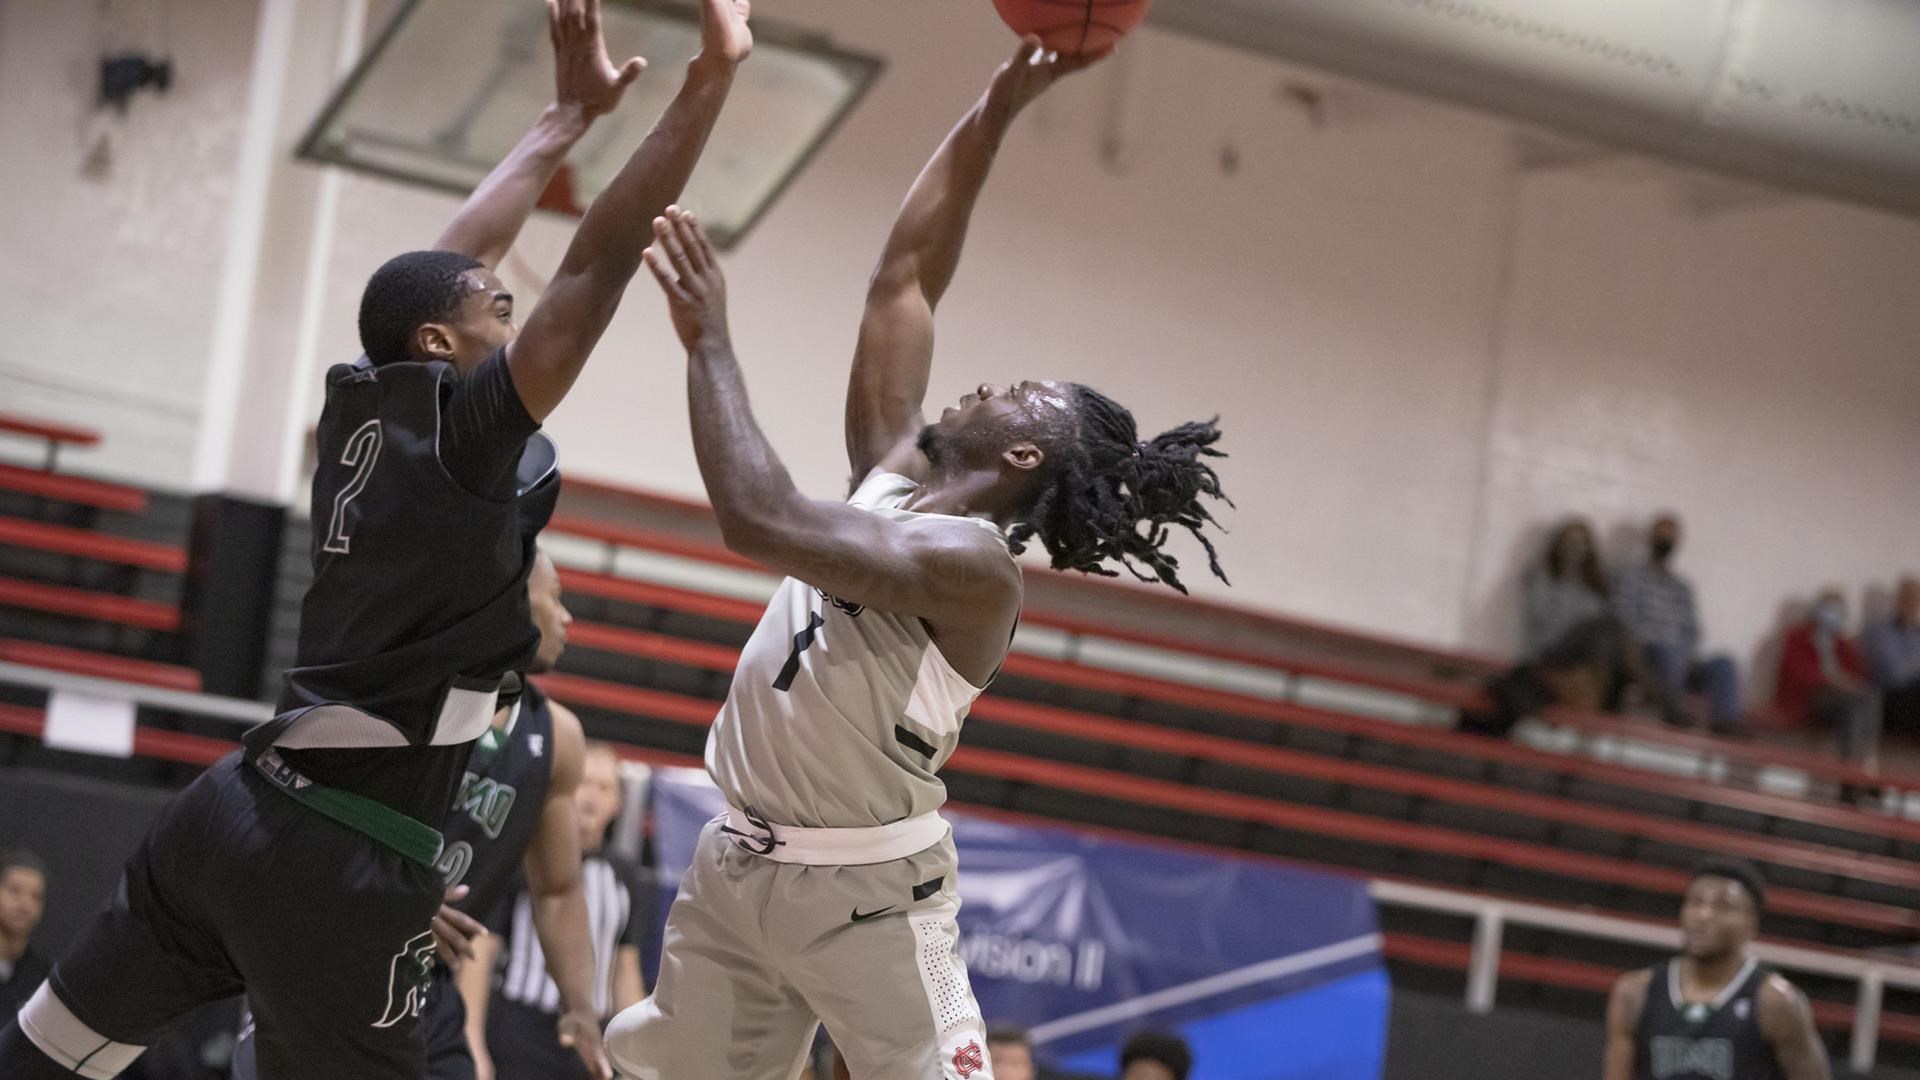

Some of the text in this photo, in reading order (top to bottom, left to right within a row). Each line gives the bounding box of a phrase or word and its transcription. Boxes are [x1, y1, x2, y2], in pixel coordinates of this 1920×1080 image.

[322, 418, 383, 554] 2
[771, 610, 825, 692] 1
[451, 770, 517, 840] MO
[957, 927, 1072, 988] vision
